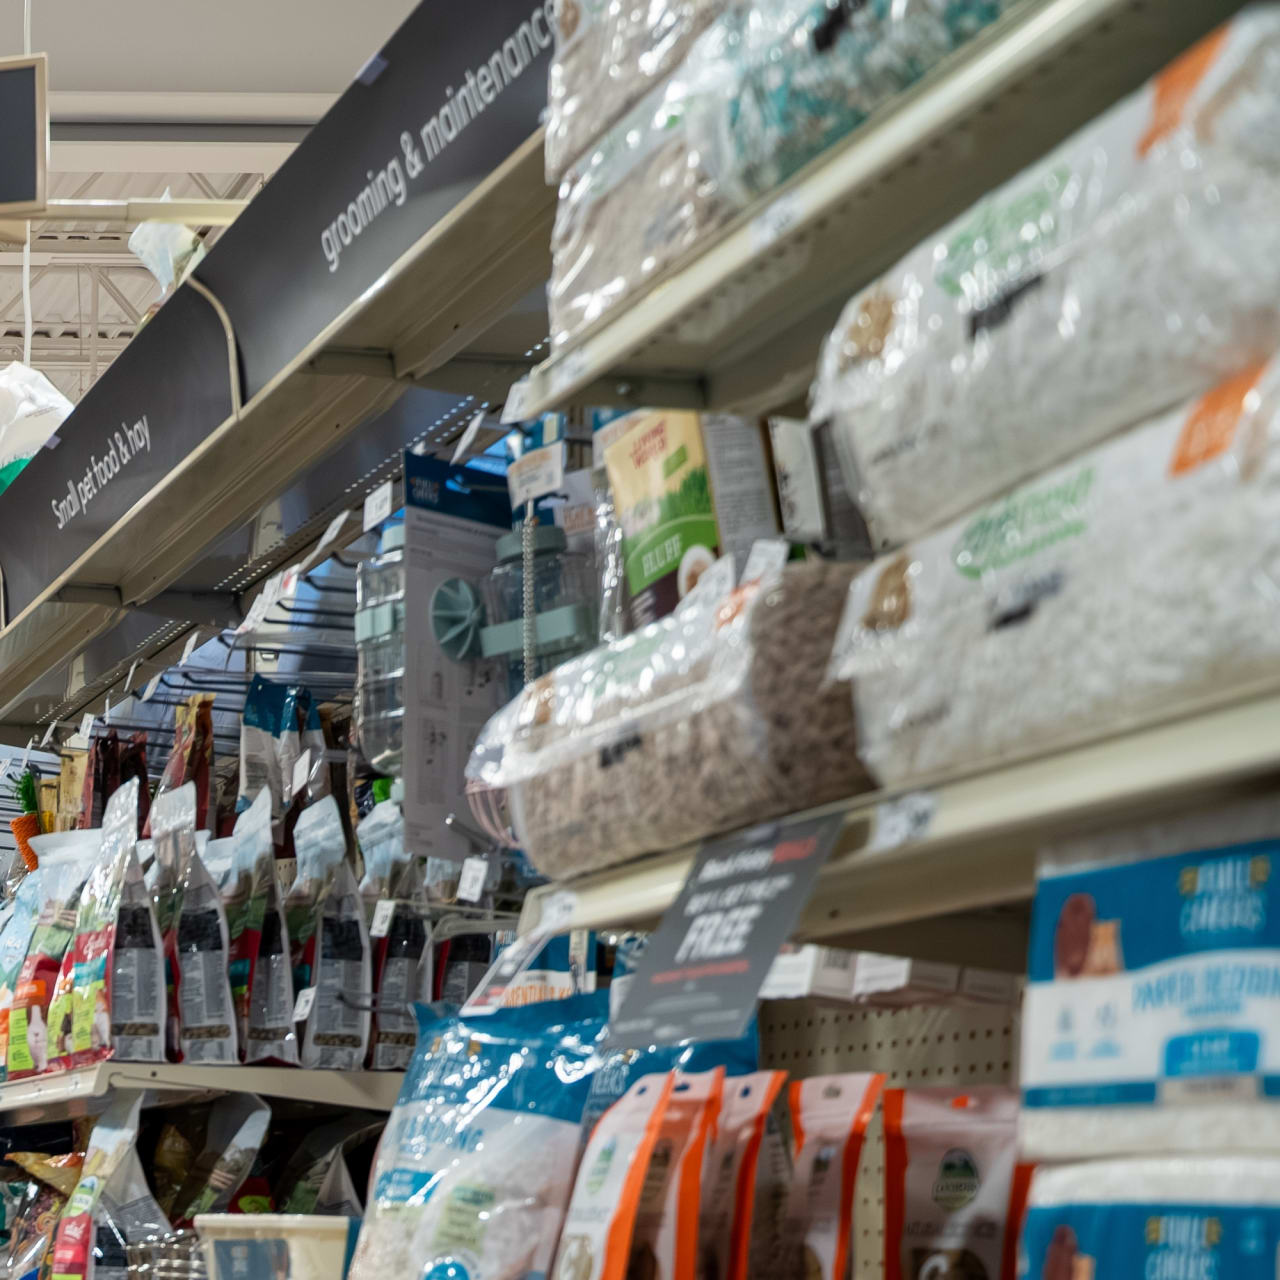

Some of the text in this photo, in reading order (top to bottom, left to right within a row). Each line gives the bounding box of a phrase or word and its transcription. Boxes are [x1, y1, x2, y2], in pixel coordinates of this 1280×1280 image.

[320, 131, 424, 273] grooming &
[51, 415, 152, 530] Small pet food & hay
